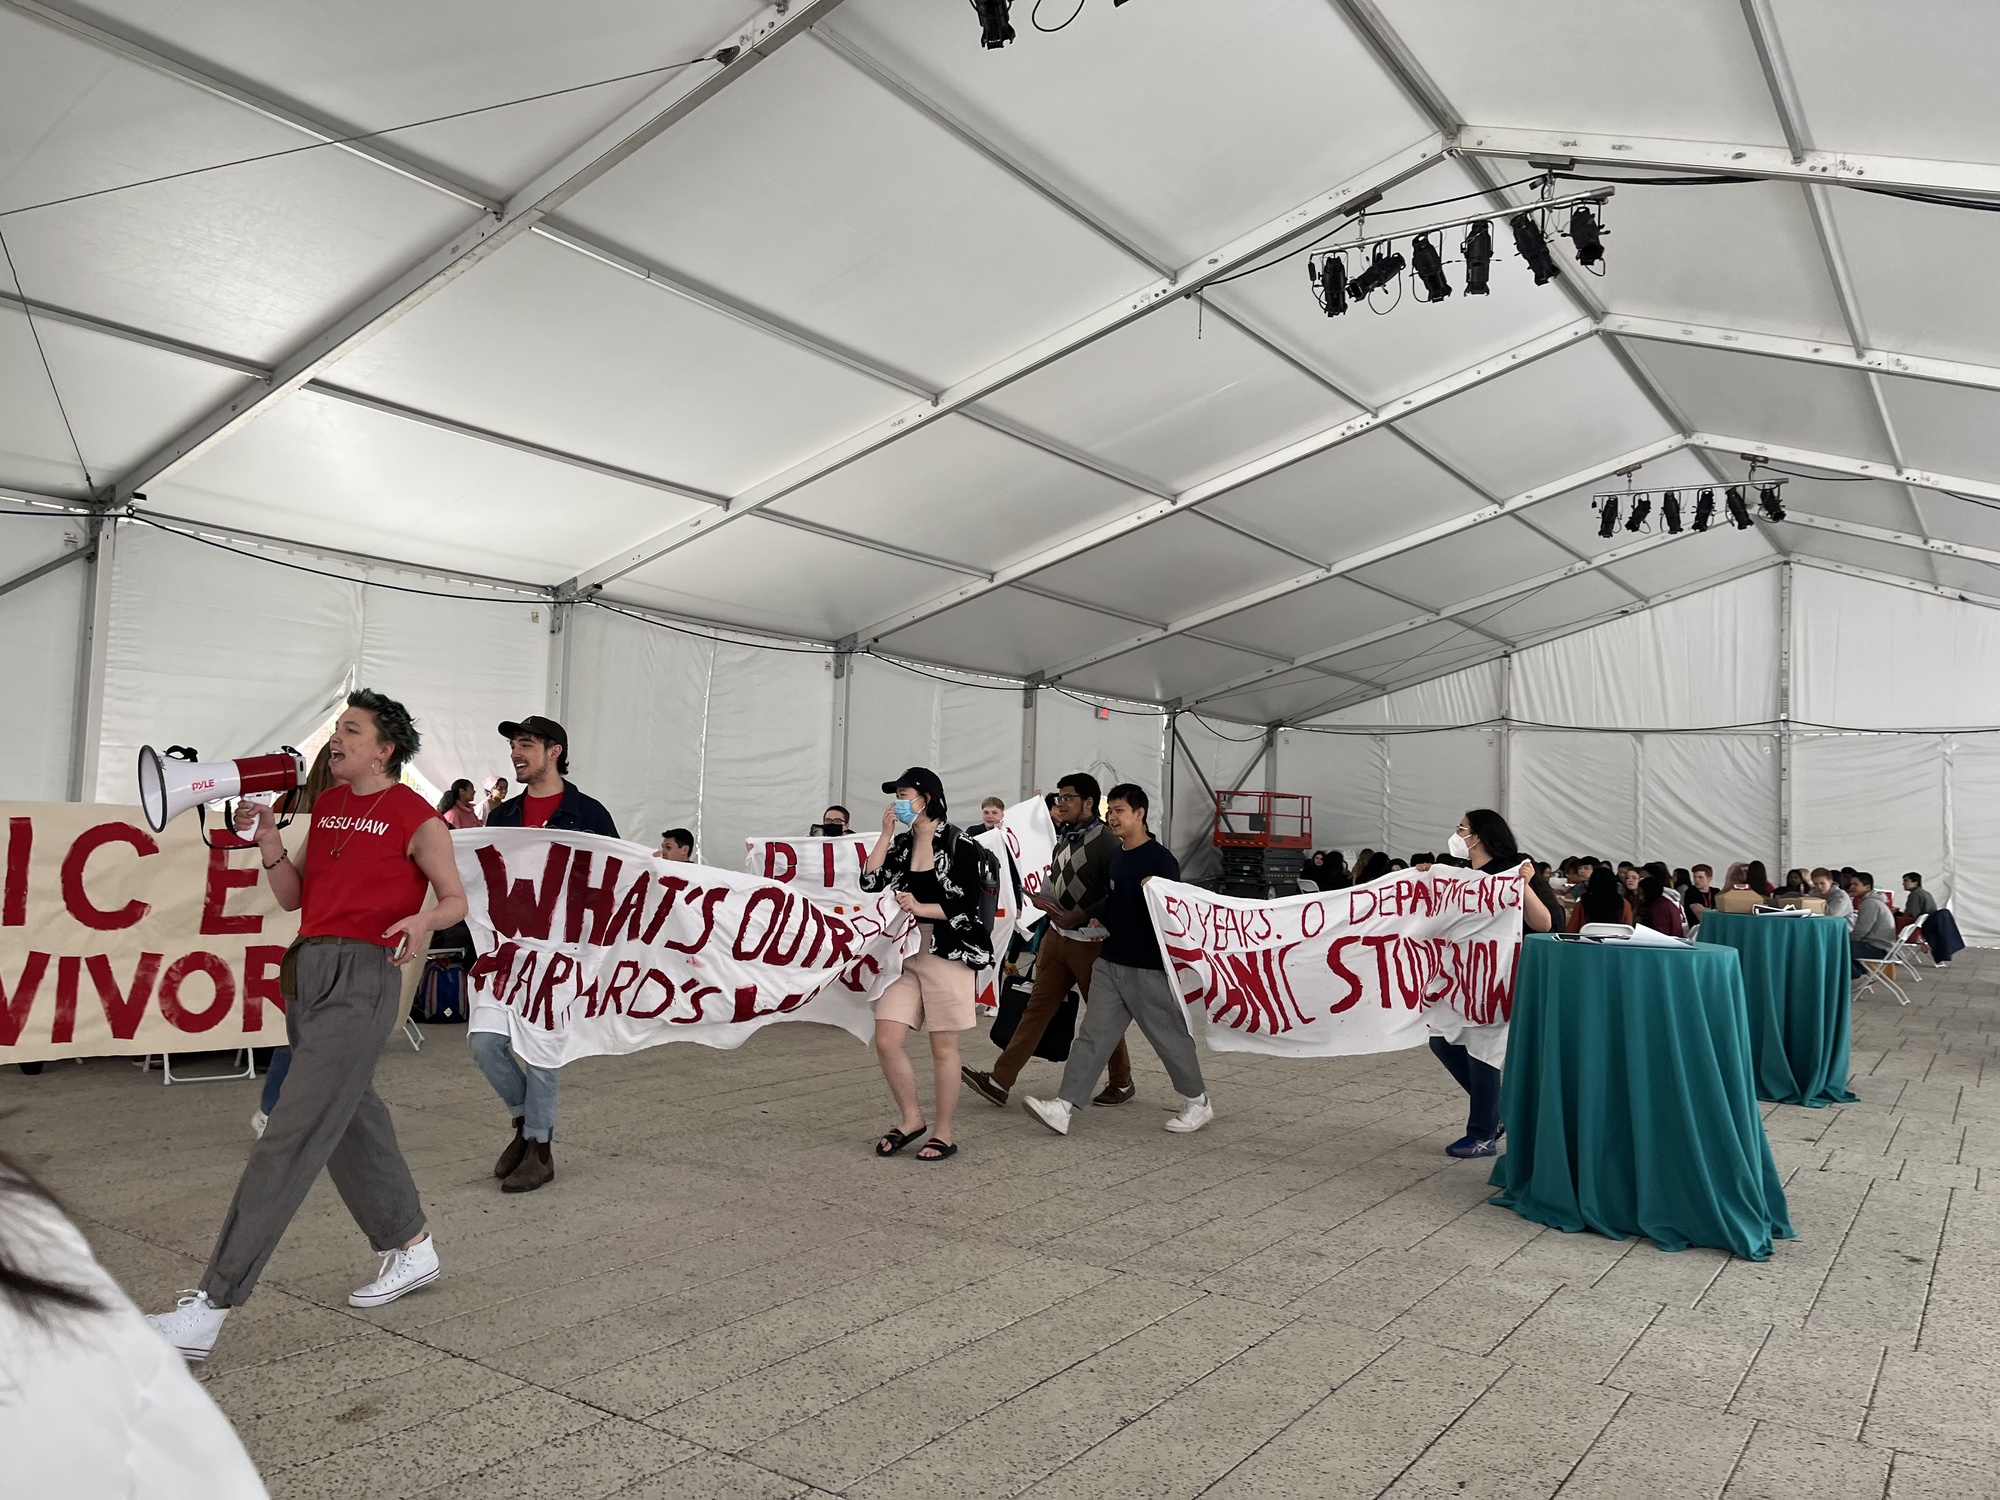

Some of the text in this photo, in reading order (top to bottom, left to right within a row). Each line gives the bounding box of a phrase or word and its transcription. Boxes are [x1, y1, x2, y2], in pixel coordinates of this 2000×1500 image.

[192, 779, 215, 791] PYLE
[317, 815, 389, 836] HGSU-UAW
[475, 842, 729, 955] WHAT'S
[1195, 903, 1282, 951] YEARS.
[1349, 876, 1523, 925] DEPARMENTS.
[1451, 940, 1522, 1025] NOW
